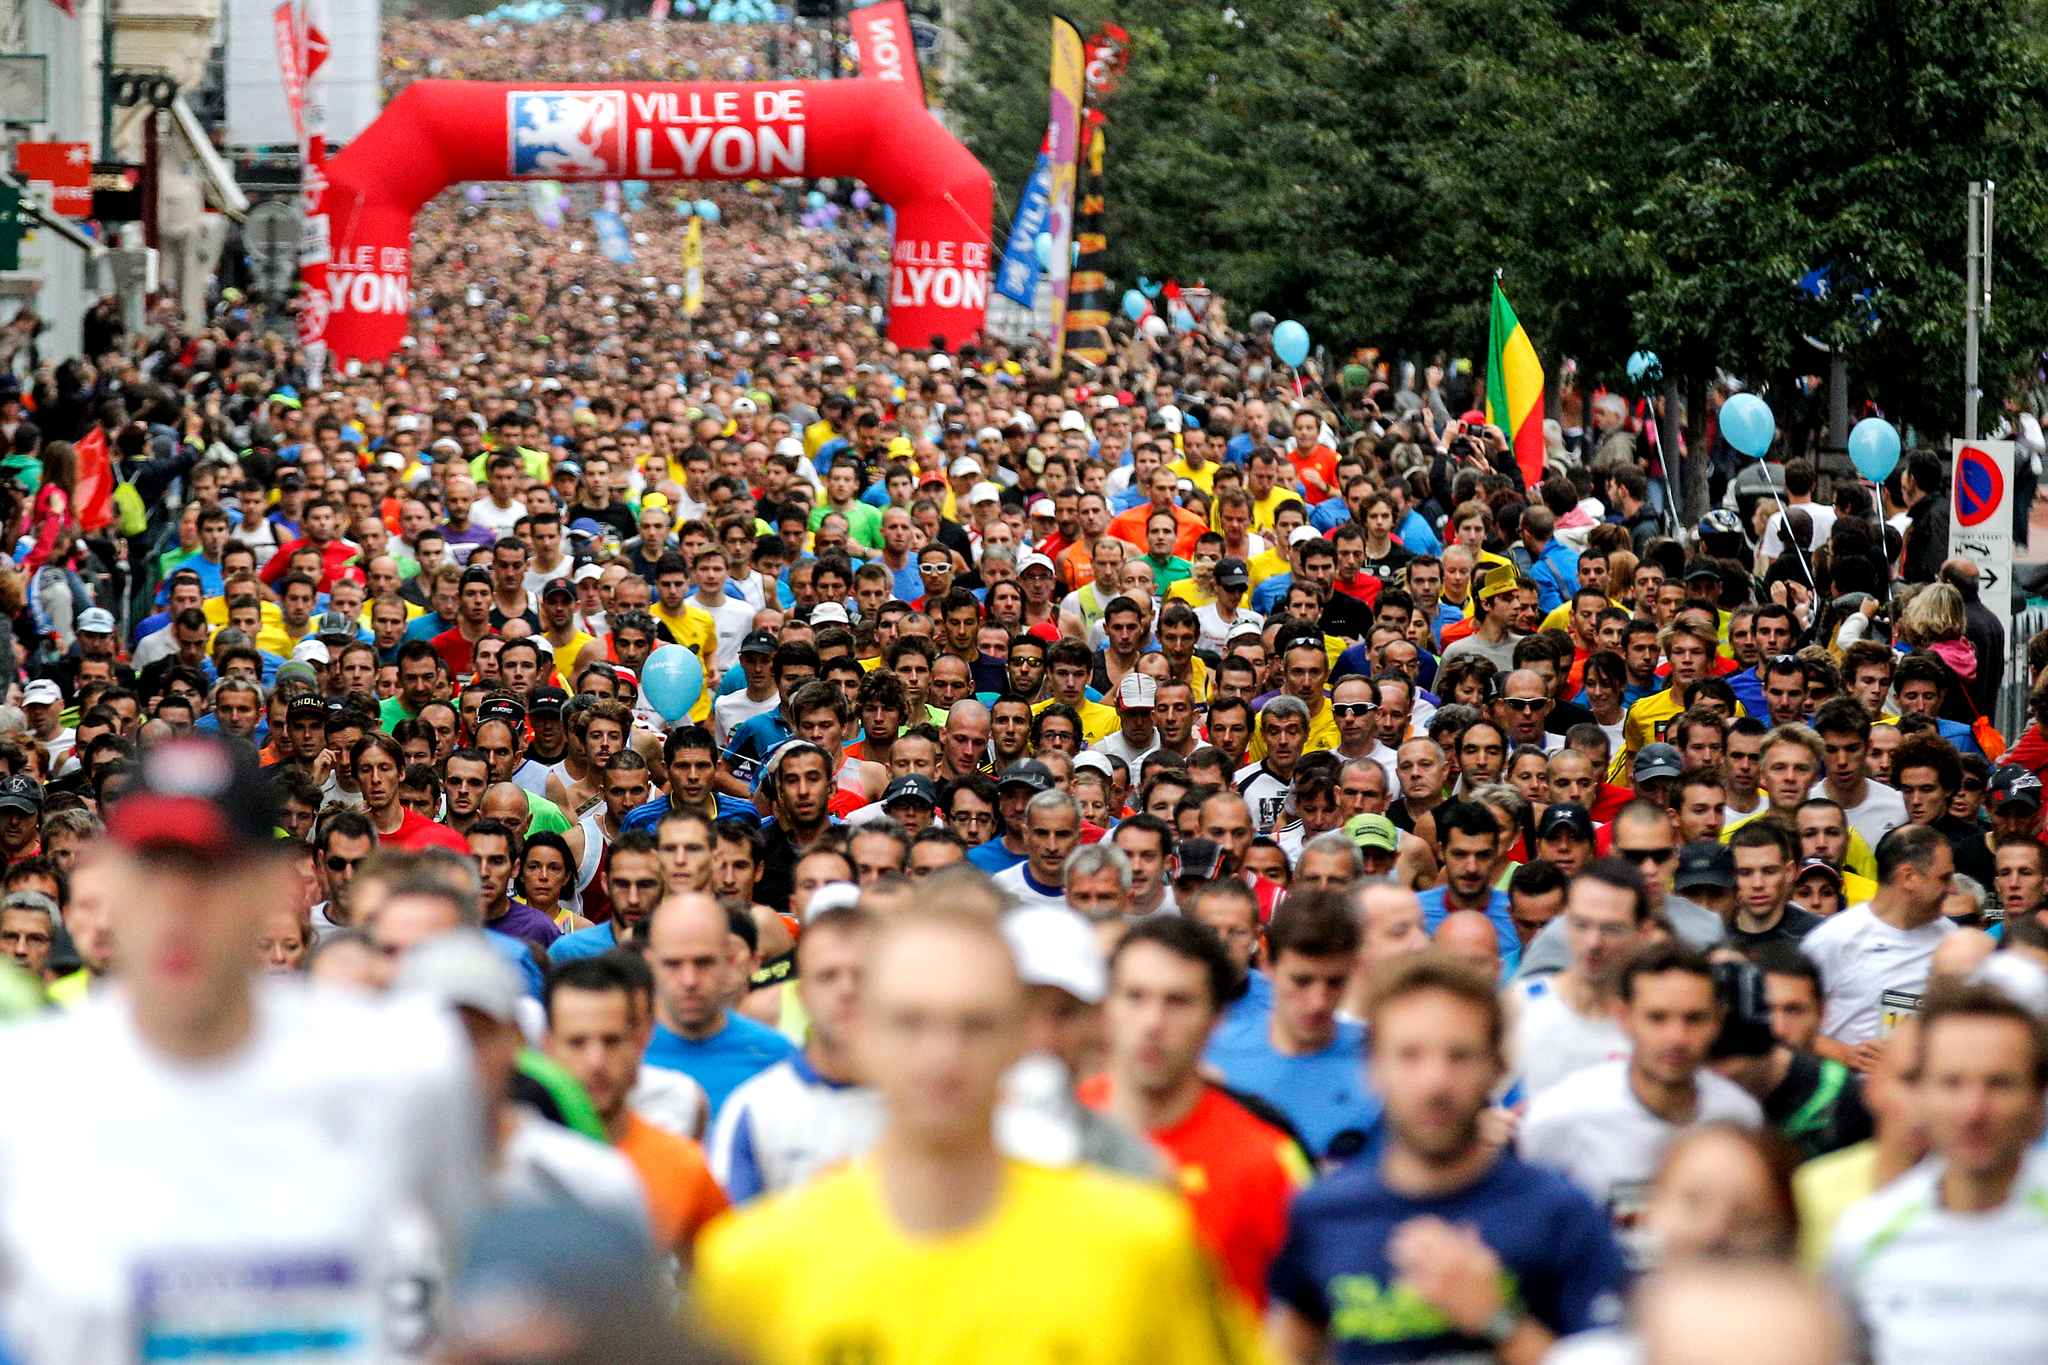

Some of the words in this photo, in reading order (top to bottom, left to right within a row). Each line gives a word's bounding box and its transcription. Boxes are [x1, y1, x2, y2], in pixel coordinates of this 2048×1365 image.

[632, 91, 740, 124] VILLE
[754, 90, 806, 122] DE
[635, 125, 806, 176] LYON
[380, 246, 408, 273] DE
[895, 240, 956, 267] VILLE
[962, 242, 988, 269] DE
[326, 271, 408, 315] YON
[892, 266, 986, 311] LYON
